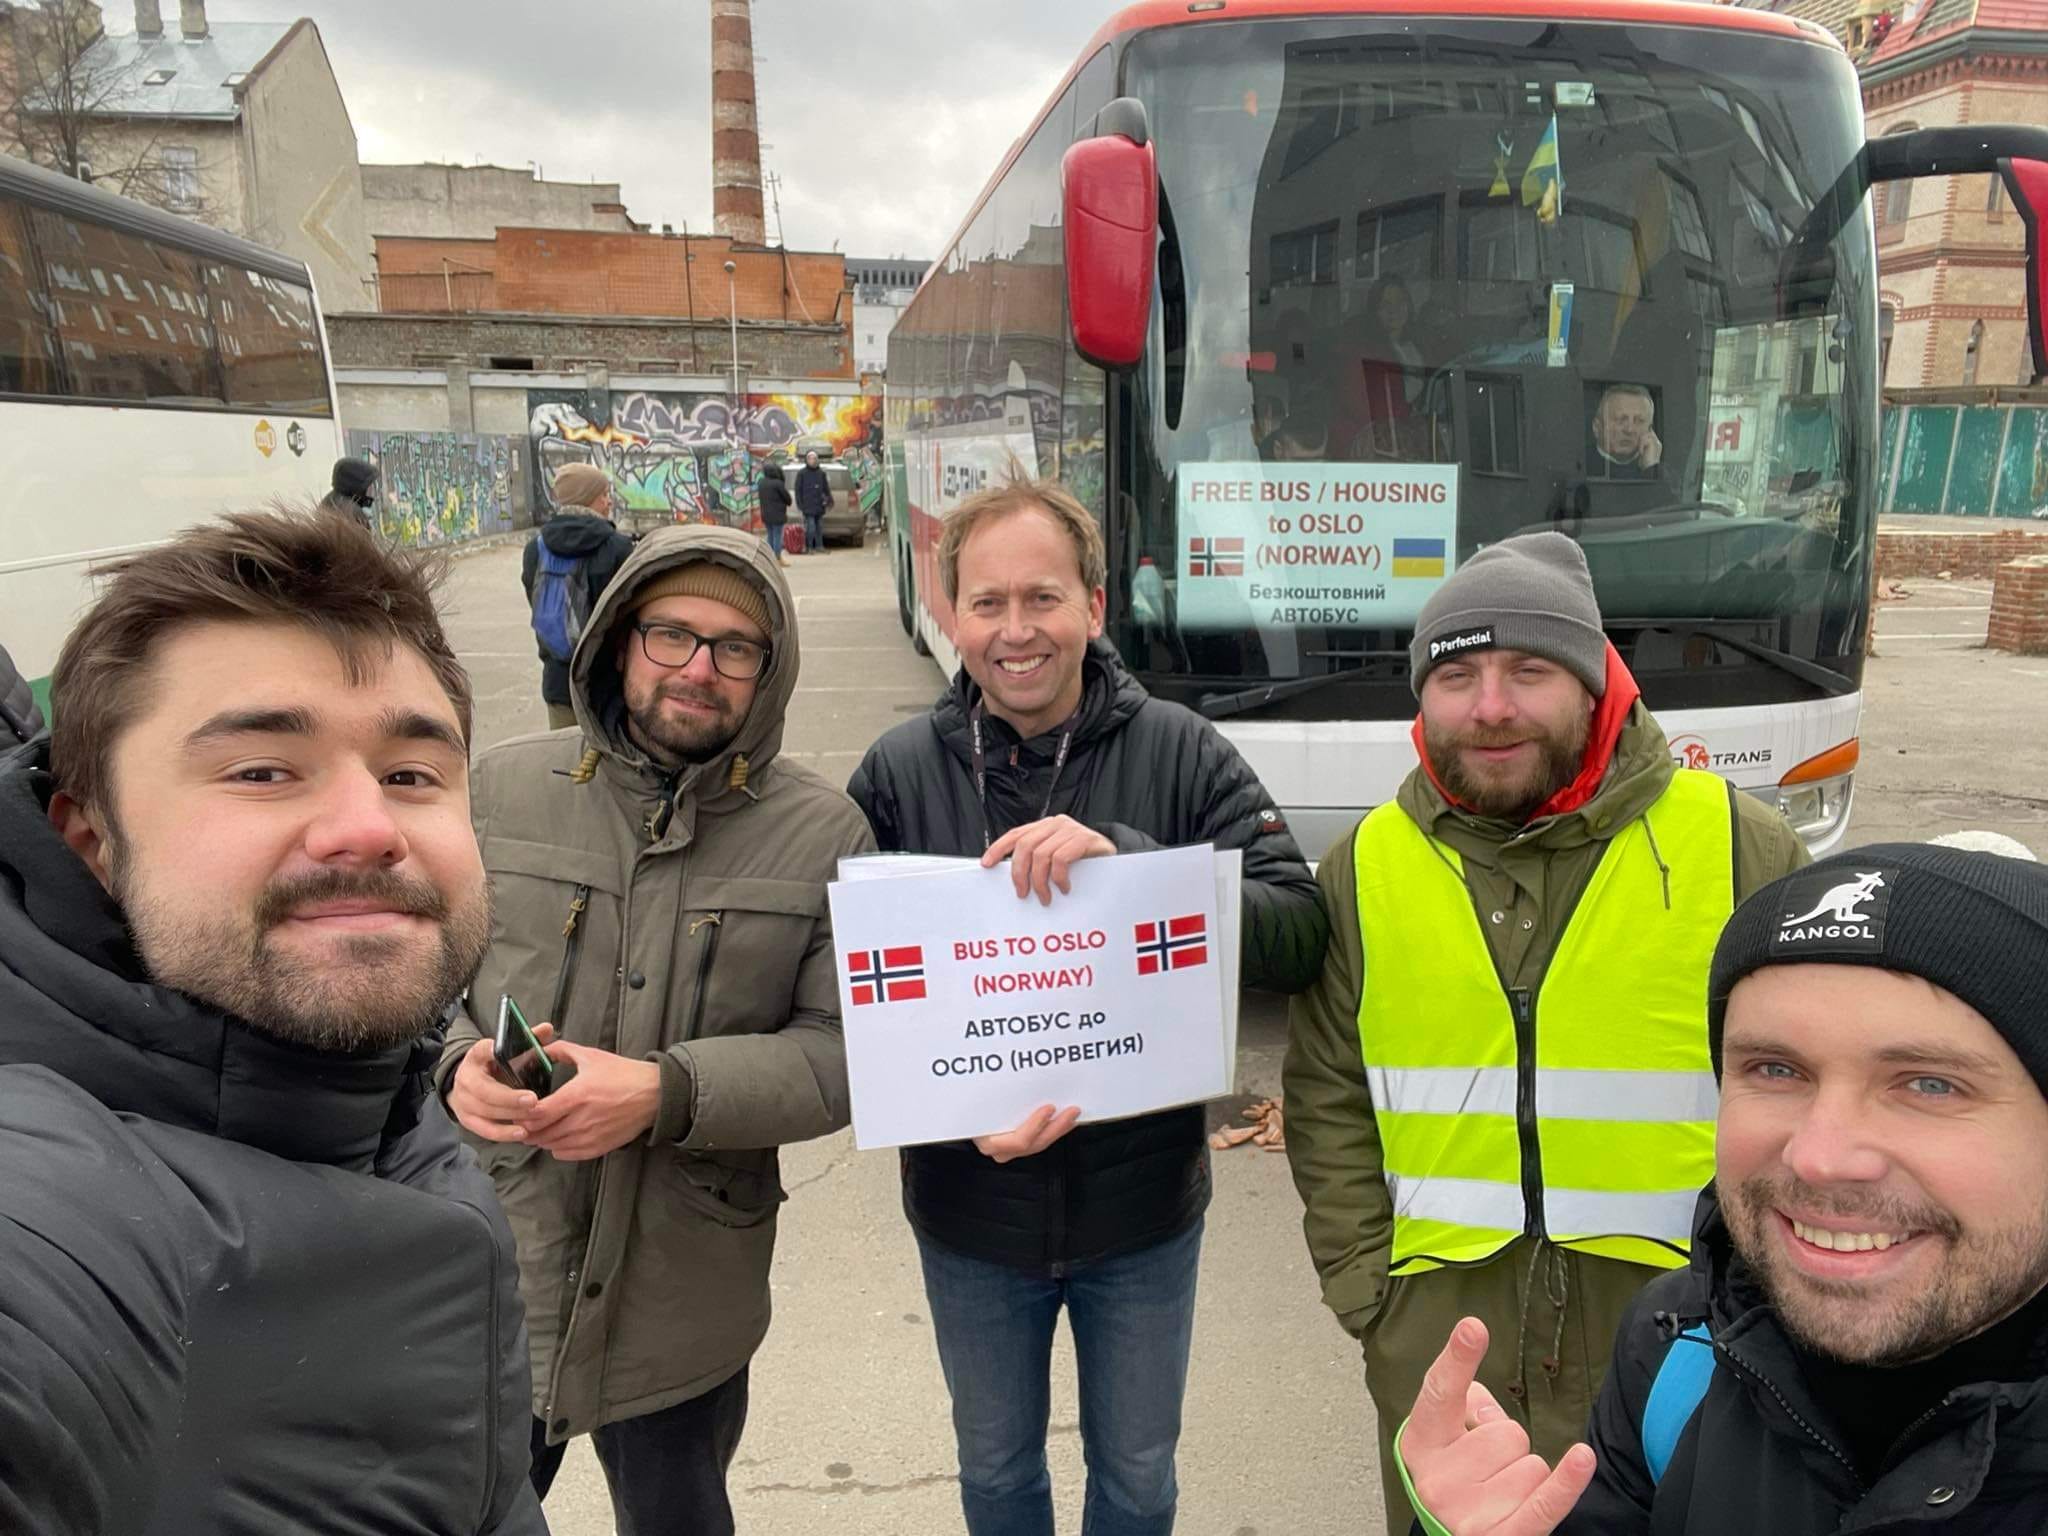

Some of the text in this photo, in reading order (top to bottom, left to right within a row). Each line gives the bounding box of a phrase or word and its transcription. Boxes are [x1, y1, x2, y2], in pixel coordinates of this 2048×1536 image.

[1190, 481, 1252, 501] FREE
[1260, 482, 1310, 502] BUS
[1334, 482, 1446, 503] HOUSING
[1268, 513, 1364, 534] to OSLO
[1256, 544, 1381, 570] (NORWAY)
[1249, 583, 1386, 600] Безкоштовний
[1271, 608, 1359, 623] АВТОБУС
[1441, 631, 1491, 652] Perfectial
[1712, 750, 1772, 765] TRANS
[1779, 925, 1875, 942] KANGOL
[953, 930, 1107, 961] BUS TO OSLO
[973, 965, 1093, 997] (NORWAY)
[964, 1011, 1106, 1039] АВТОБУС до
[931, 1033, 1143, 1077] ОСЛО (НОРВЕГИЯ)
